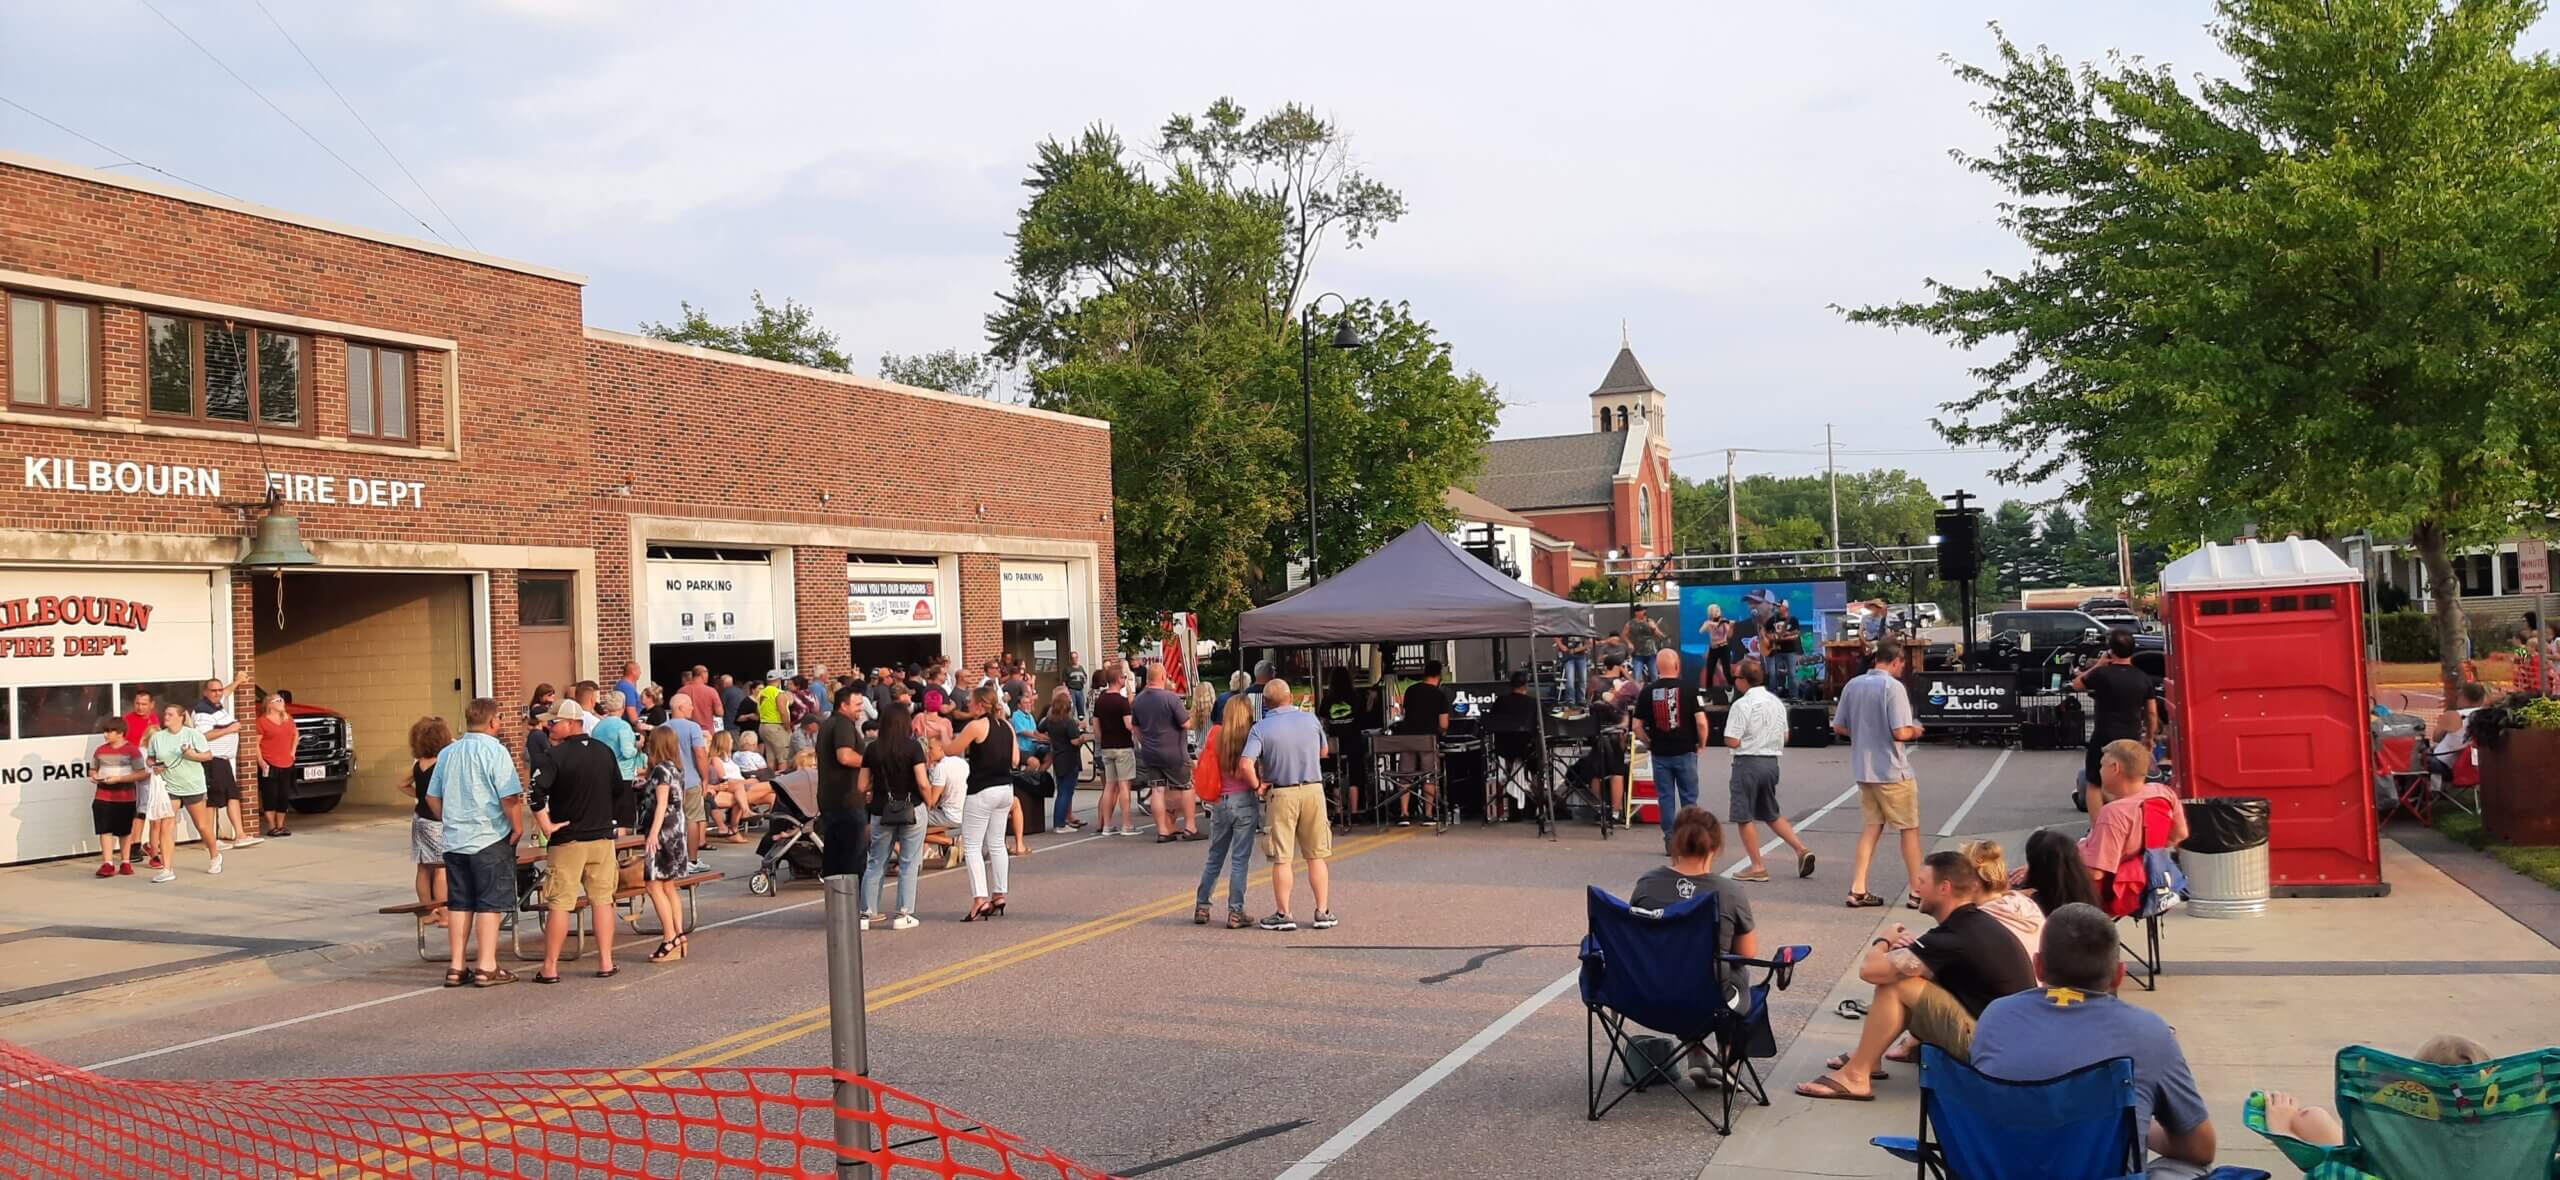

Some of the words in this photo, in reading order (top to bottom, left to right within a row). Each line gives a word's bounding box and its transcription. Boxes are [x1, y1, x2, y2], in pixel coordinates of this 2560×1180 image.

[24, 456, 221, 497] KILBOURN
[266, 472, 336, 504] FIRE
[347, 478, 425, 508] DEPT
[1003, 572, 1013, 581] NO
[1016, 573, 1044, 582] PARKING
[666, 579, 682, 591] NO
[686, 580, 732, 591] PARKING
[850, 583, 868, 594] THANK
[869, 583, 880, 594] YOU
[881, 584, 888, 594] TO
[888, 584, 899, 594] OUR
[900, 584, 926, 594] SPONSORS
[0, 595, 153, 632] ILBOURN
[0, 636, 54, 658] FIRE
[64, 636, 128, 657] DEPT.
[1928, 681, 2006, 696] Absolute
[1452, 691, 1497, 704] Absol
[1944, 695, 1999, 710] Audio
[2, 767, 33, 784] NO
